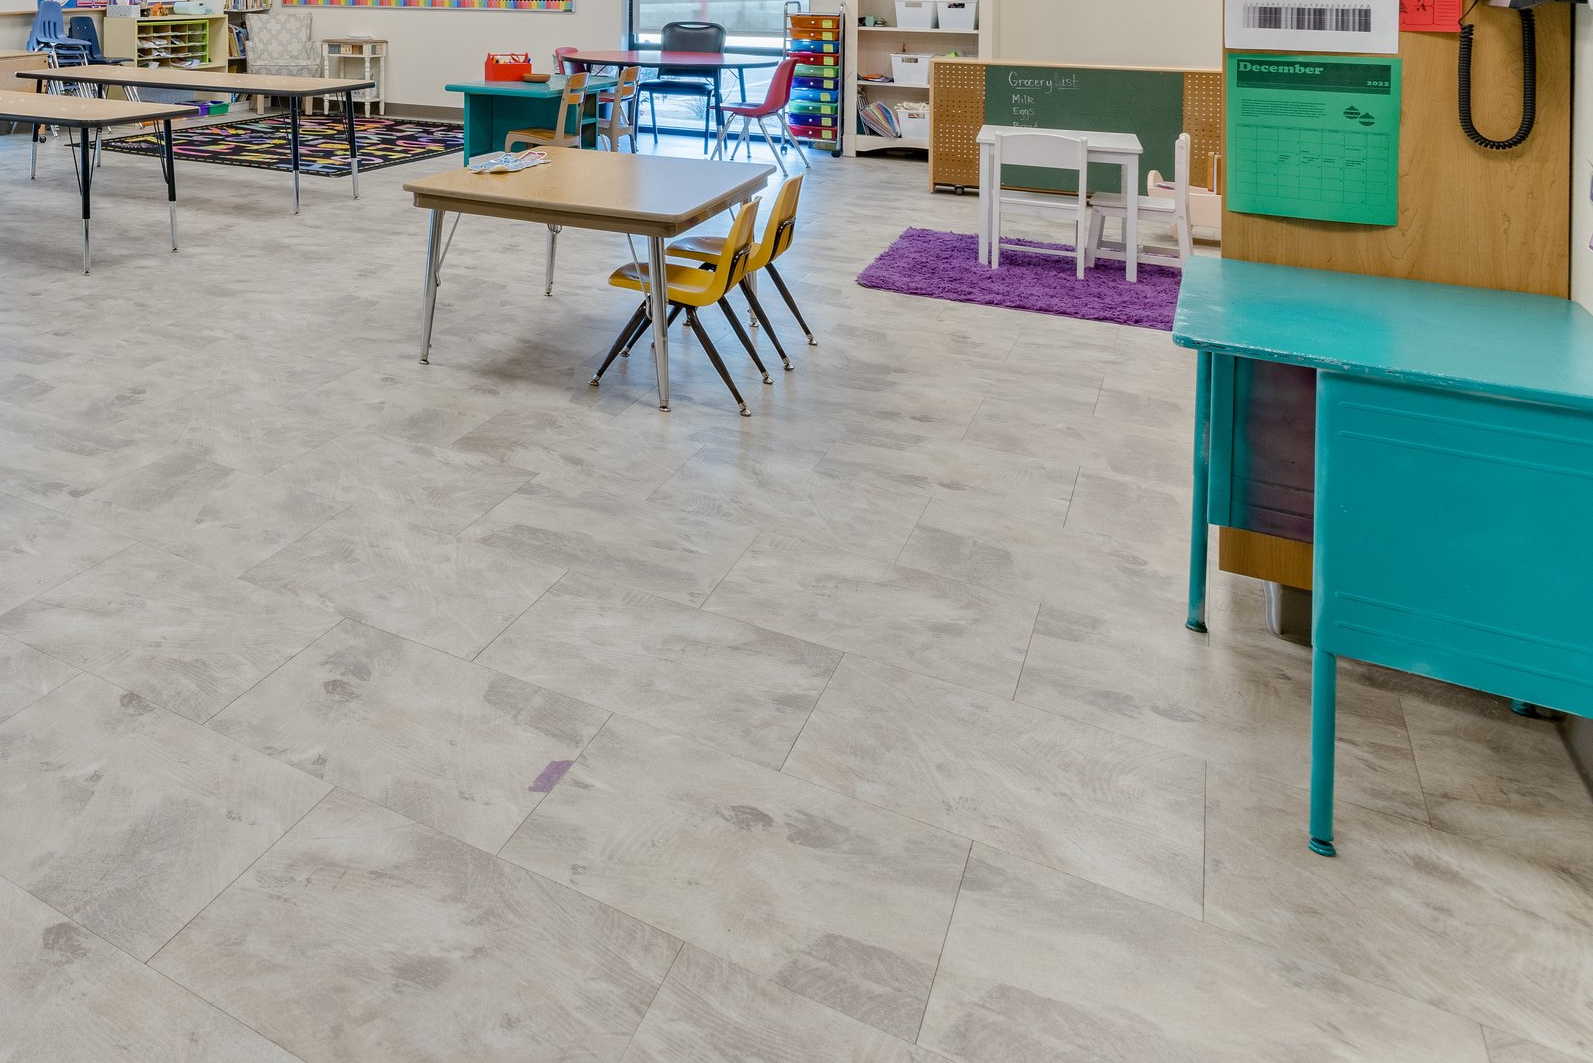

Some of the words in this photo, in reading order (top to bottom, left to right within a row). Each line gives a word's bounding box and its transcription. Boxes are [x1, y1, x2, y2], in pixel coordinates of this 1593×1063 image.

[1238, 61, 1324, 75] December
[1008, 71, 1053, 94] Grocery
[1012, 94, 1035, 105] Milk
[1012, 106, 1035, 121] Eggs
